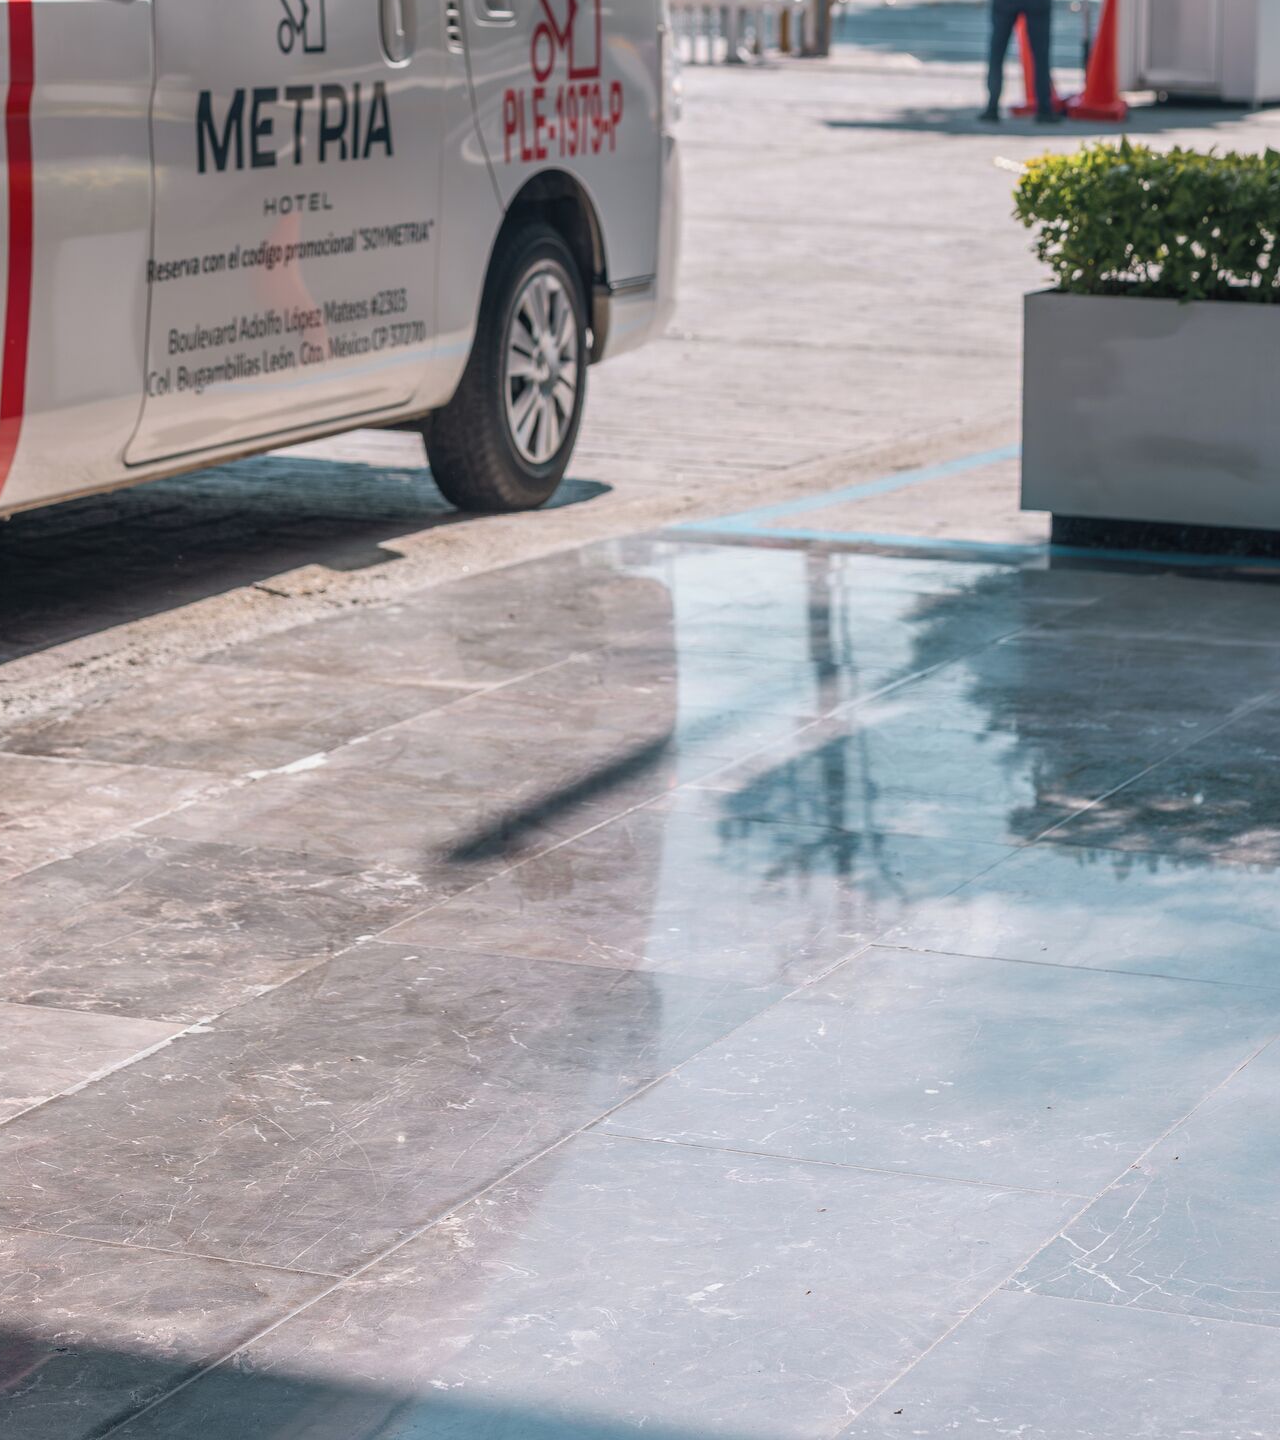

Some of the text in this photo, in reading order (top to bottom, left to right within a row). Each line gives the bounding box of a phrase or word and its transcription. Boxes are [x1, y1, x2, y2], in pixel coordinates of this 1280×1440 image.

[195, 81, 394, 174] METRIA
[263, 192, 334, 216] HOTEL
[146, 256, 200, 284] Reserva
[202, 253, 226, 274] con
[228, 242, 240, 270] el
[283, 227, 357, 267] promocional
[168, 315, 237, 355] Boulevard
[239, 308, 282, 341] Adolfo
[284, 305, 322, 336] López
[323, 295, 369, 324] Mateos
[327, 330, 371, 359] México
